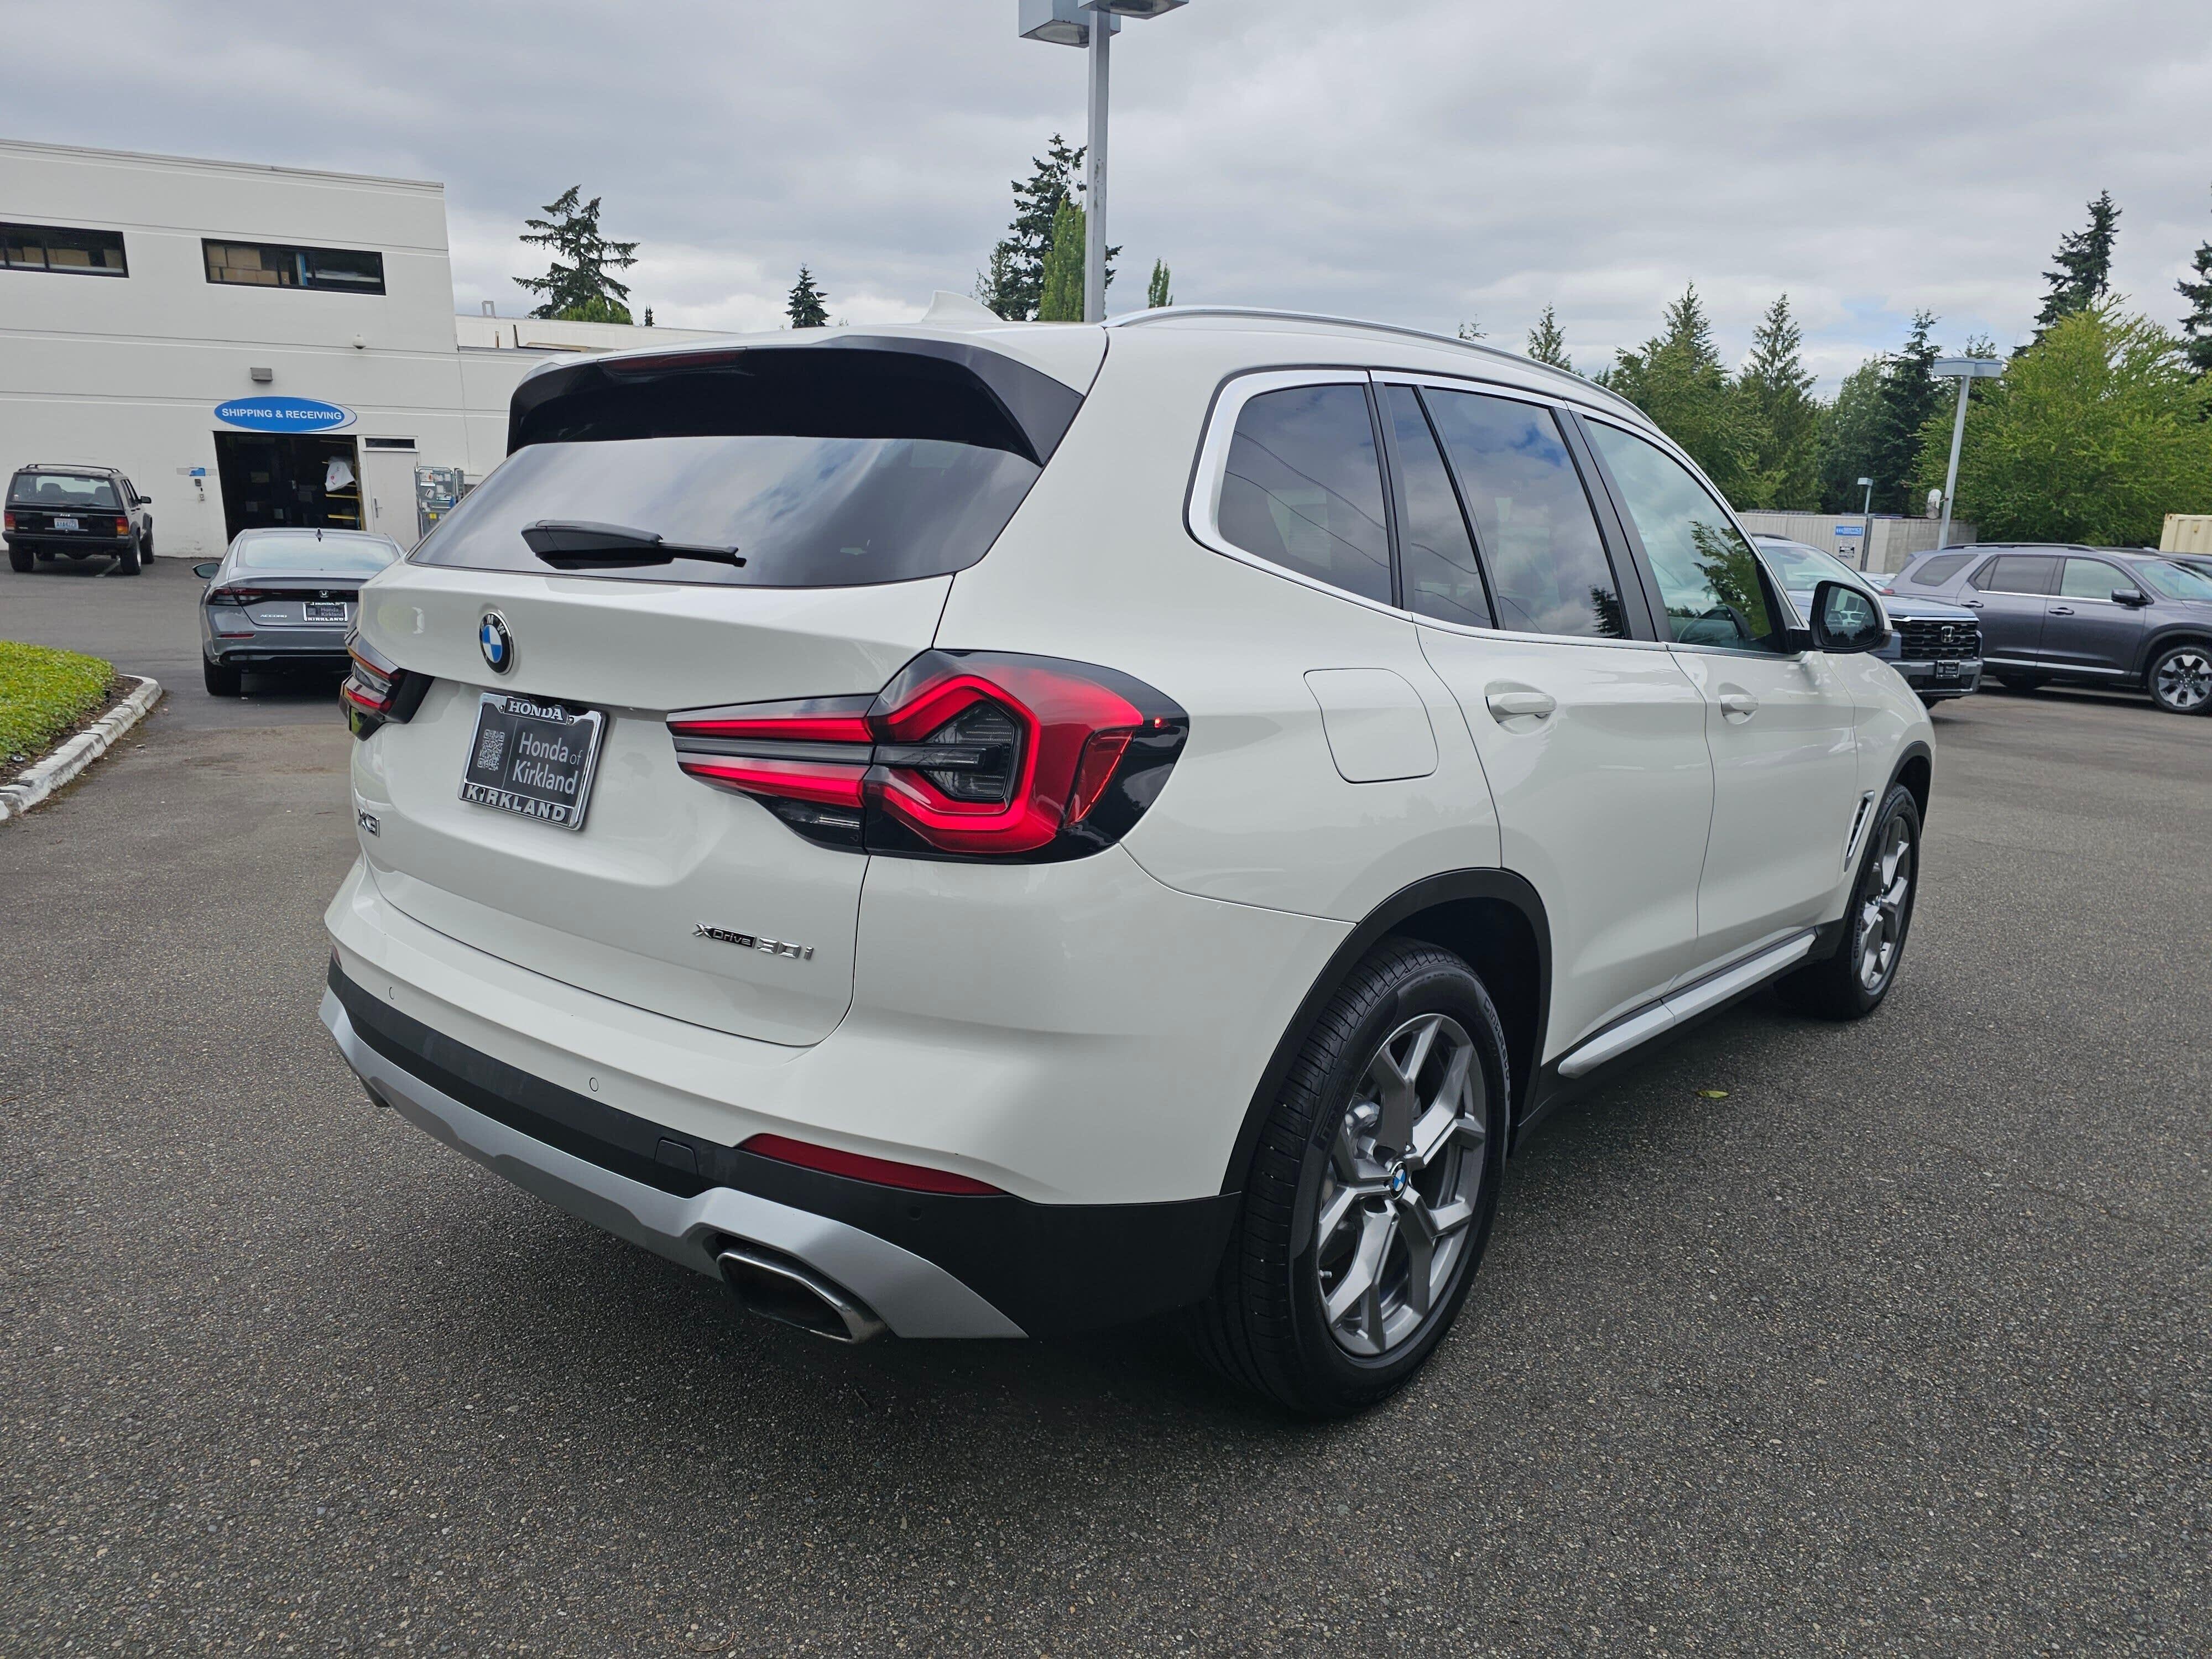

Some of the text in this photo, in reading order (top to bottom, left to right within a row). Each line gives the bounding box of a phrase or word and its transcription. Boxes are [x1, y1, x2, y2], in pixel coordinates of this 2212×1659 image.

[222, 408, 342, 420] SHIPPING & RECEIVING
[508, 701, 564, 721] HONDA
[519, 732, 583, 766] Honda of
[512, 759, 579, 795] Kirkland
[467, 785, 566, 822] KIRKLAND
